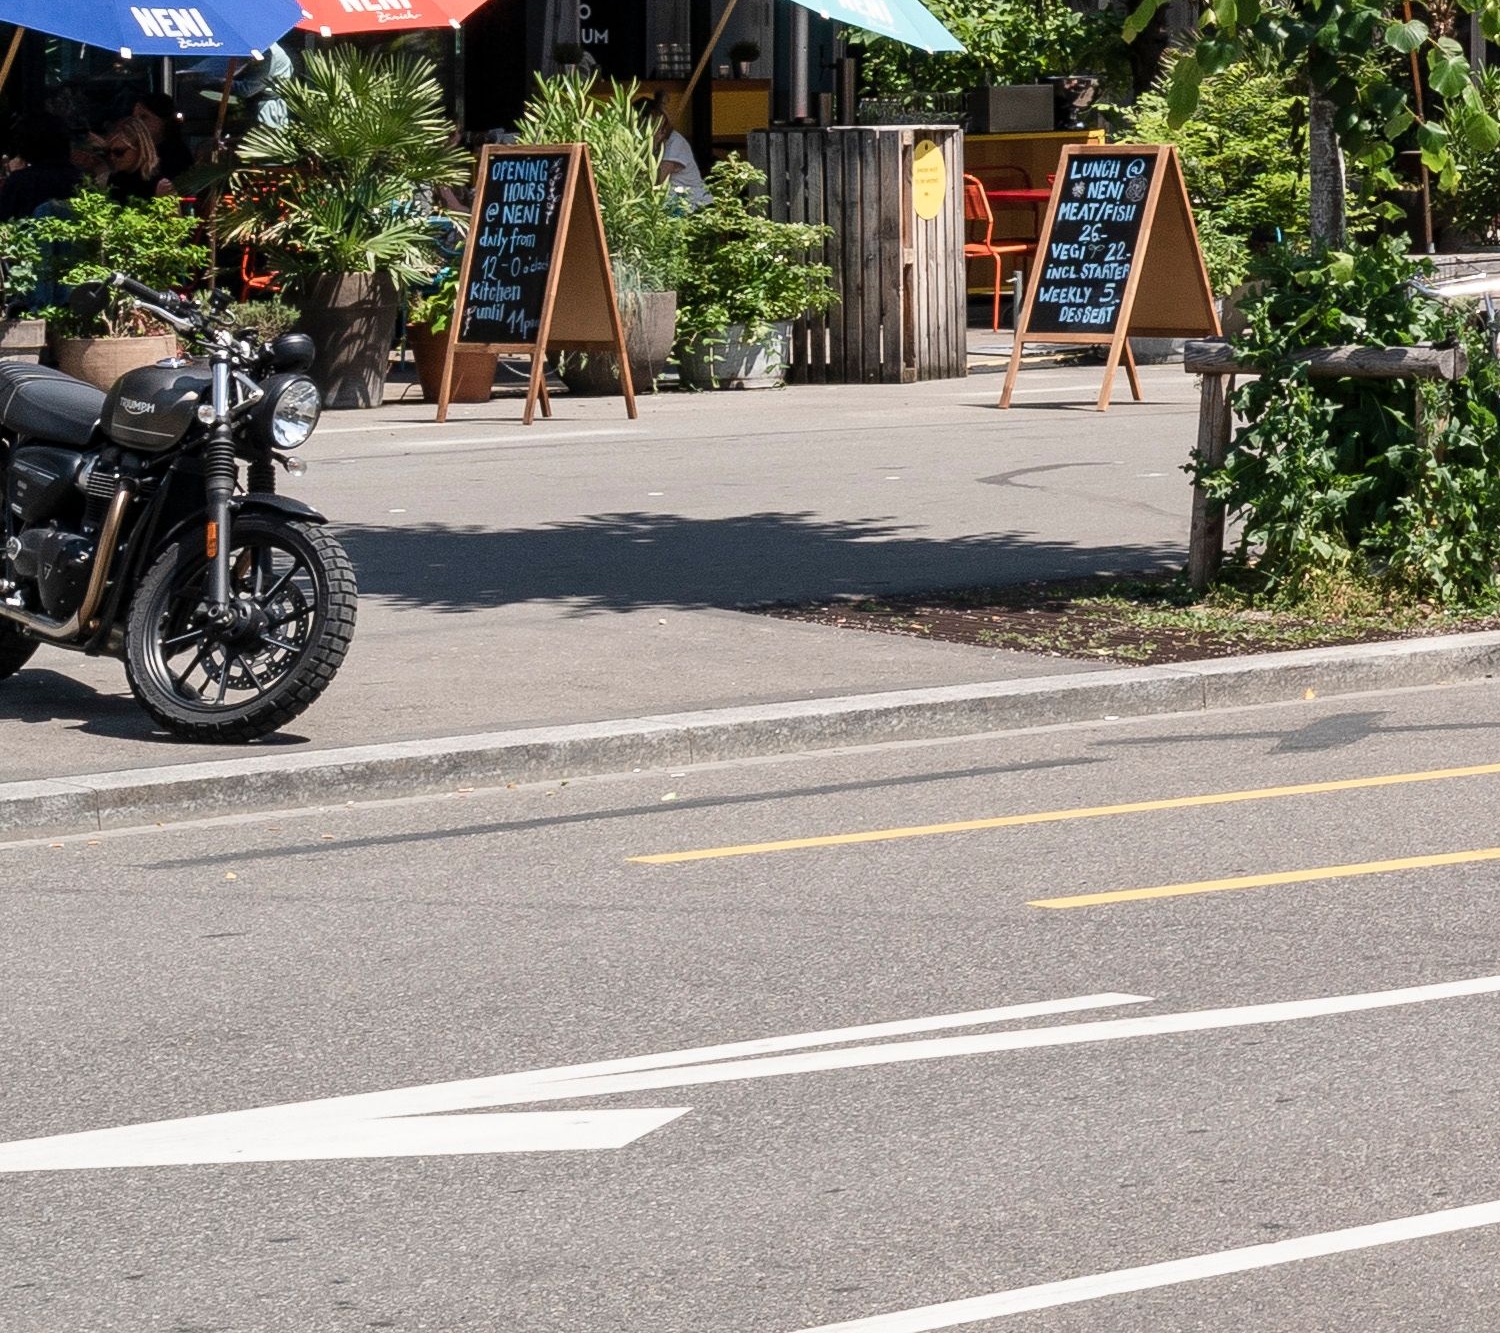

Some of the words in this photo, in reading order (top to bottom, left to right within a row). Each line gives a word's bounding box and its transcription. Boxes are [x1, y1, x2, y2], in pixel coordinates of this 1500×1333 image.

[130, 6, 214, 37] NENI
[1070, 160, 1121, 179] LUNCH
[1125, 158, 1146, 179] @
[503, 182, 546, 202] HOURS
[485, 202, 500, 223] @
[479, 226, 508, 256] daily
[510, 228, 536, 254] from
[481, 256, 498, 281] 12
[469, 280, 521, 301] Kitchen
[1038, 285, 1093, 304] WEEKLY
[476, 305, 505, 322] until
[1058, 306, 1116, 325] DESSERT
[119, 396, 156, 415] TRIUMPH
